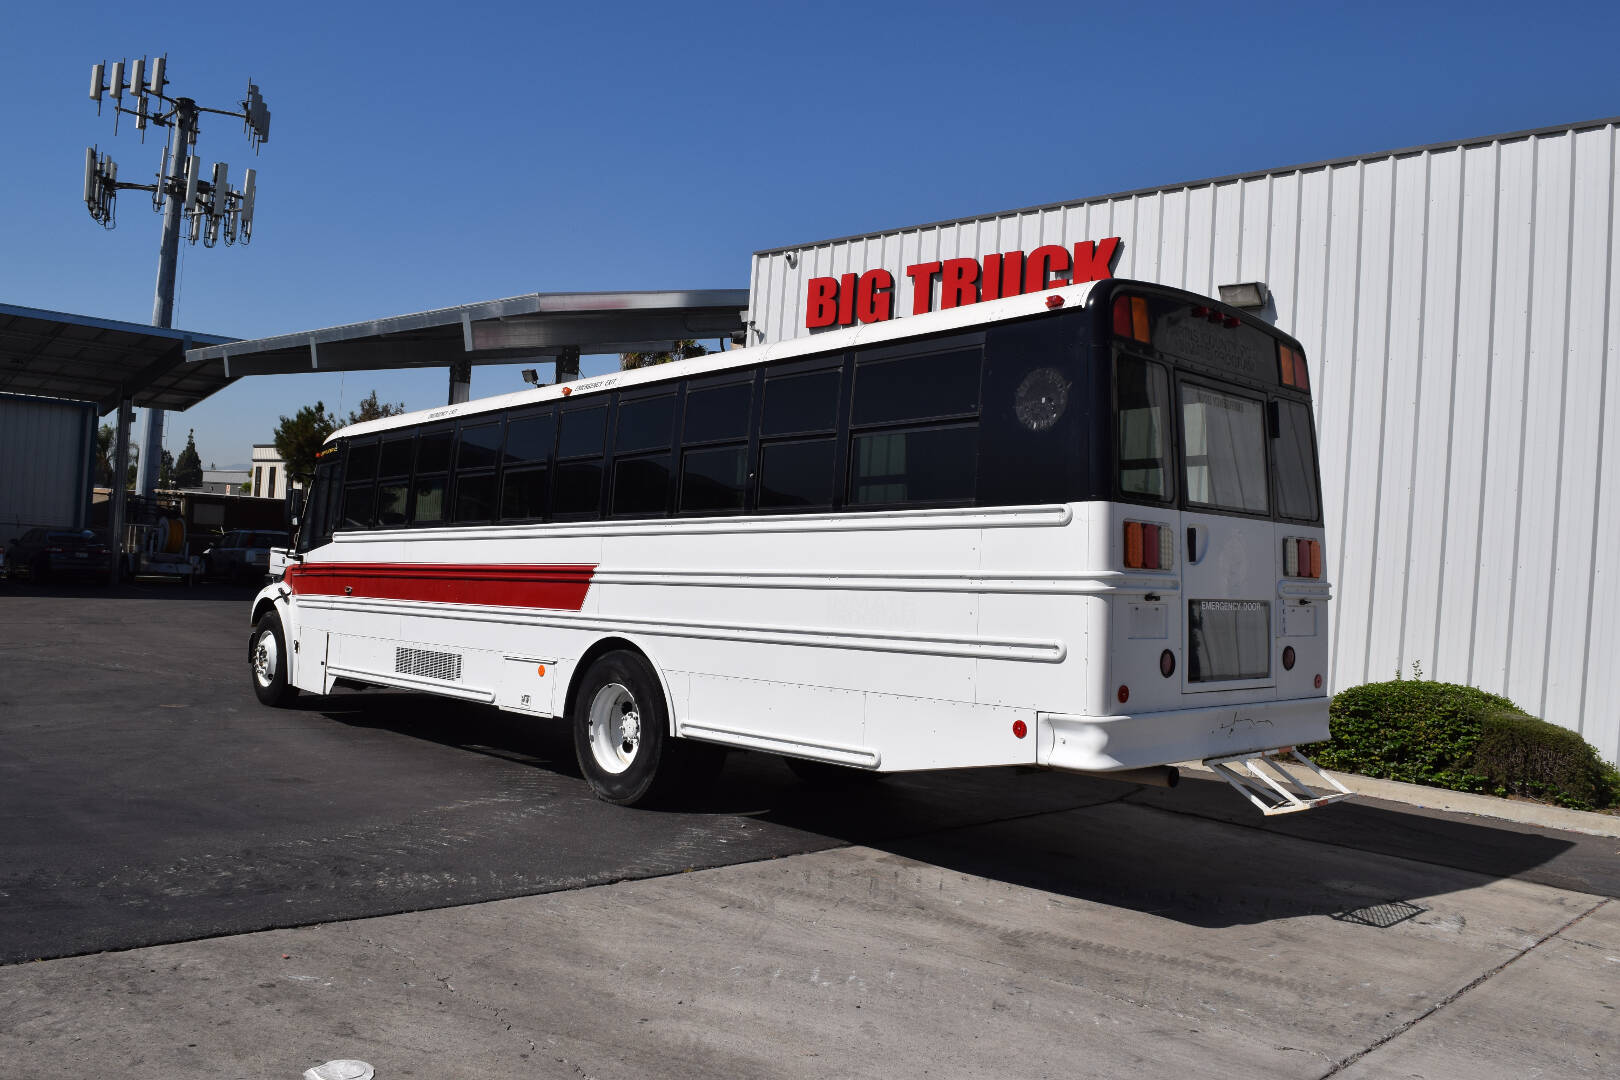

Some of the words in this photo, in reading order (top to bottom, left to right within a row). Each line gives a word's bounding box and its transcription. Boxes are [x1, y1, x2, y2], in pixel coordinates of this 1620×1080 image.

[805, 268, 891, 329] BIG
[906, 237, 1121, 316] TRUCK
[574, 380, 604, 392] EMERGENCY
[605, 378, 617, 387] EXIT
[1201, 601, 1240, 611] EMERGENCY
[1244, 602, 1261, 611] DOOR
